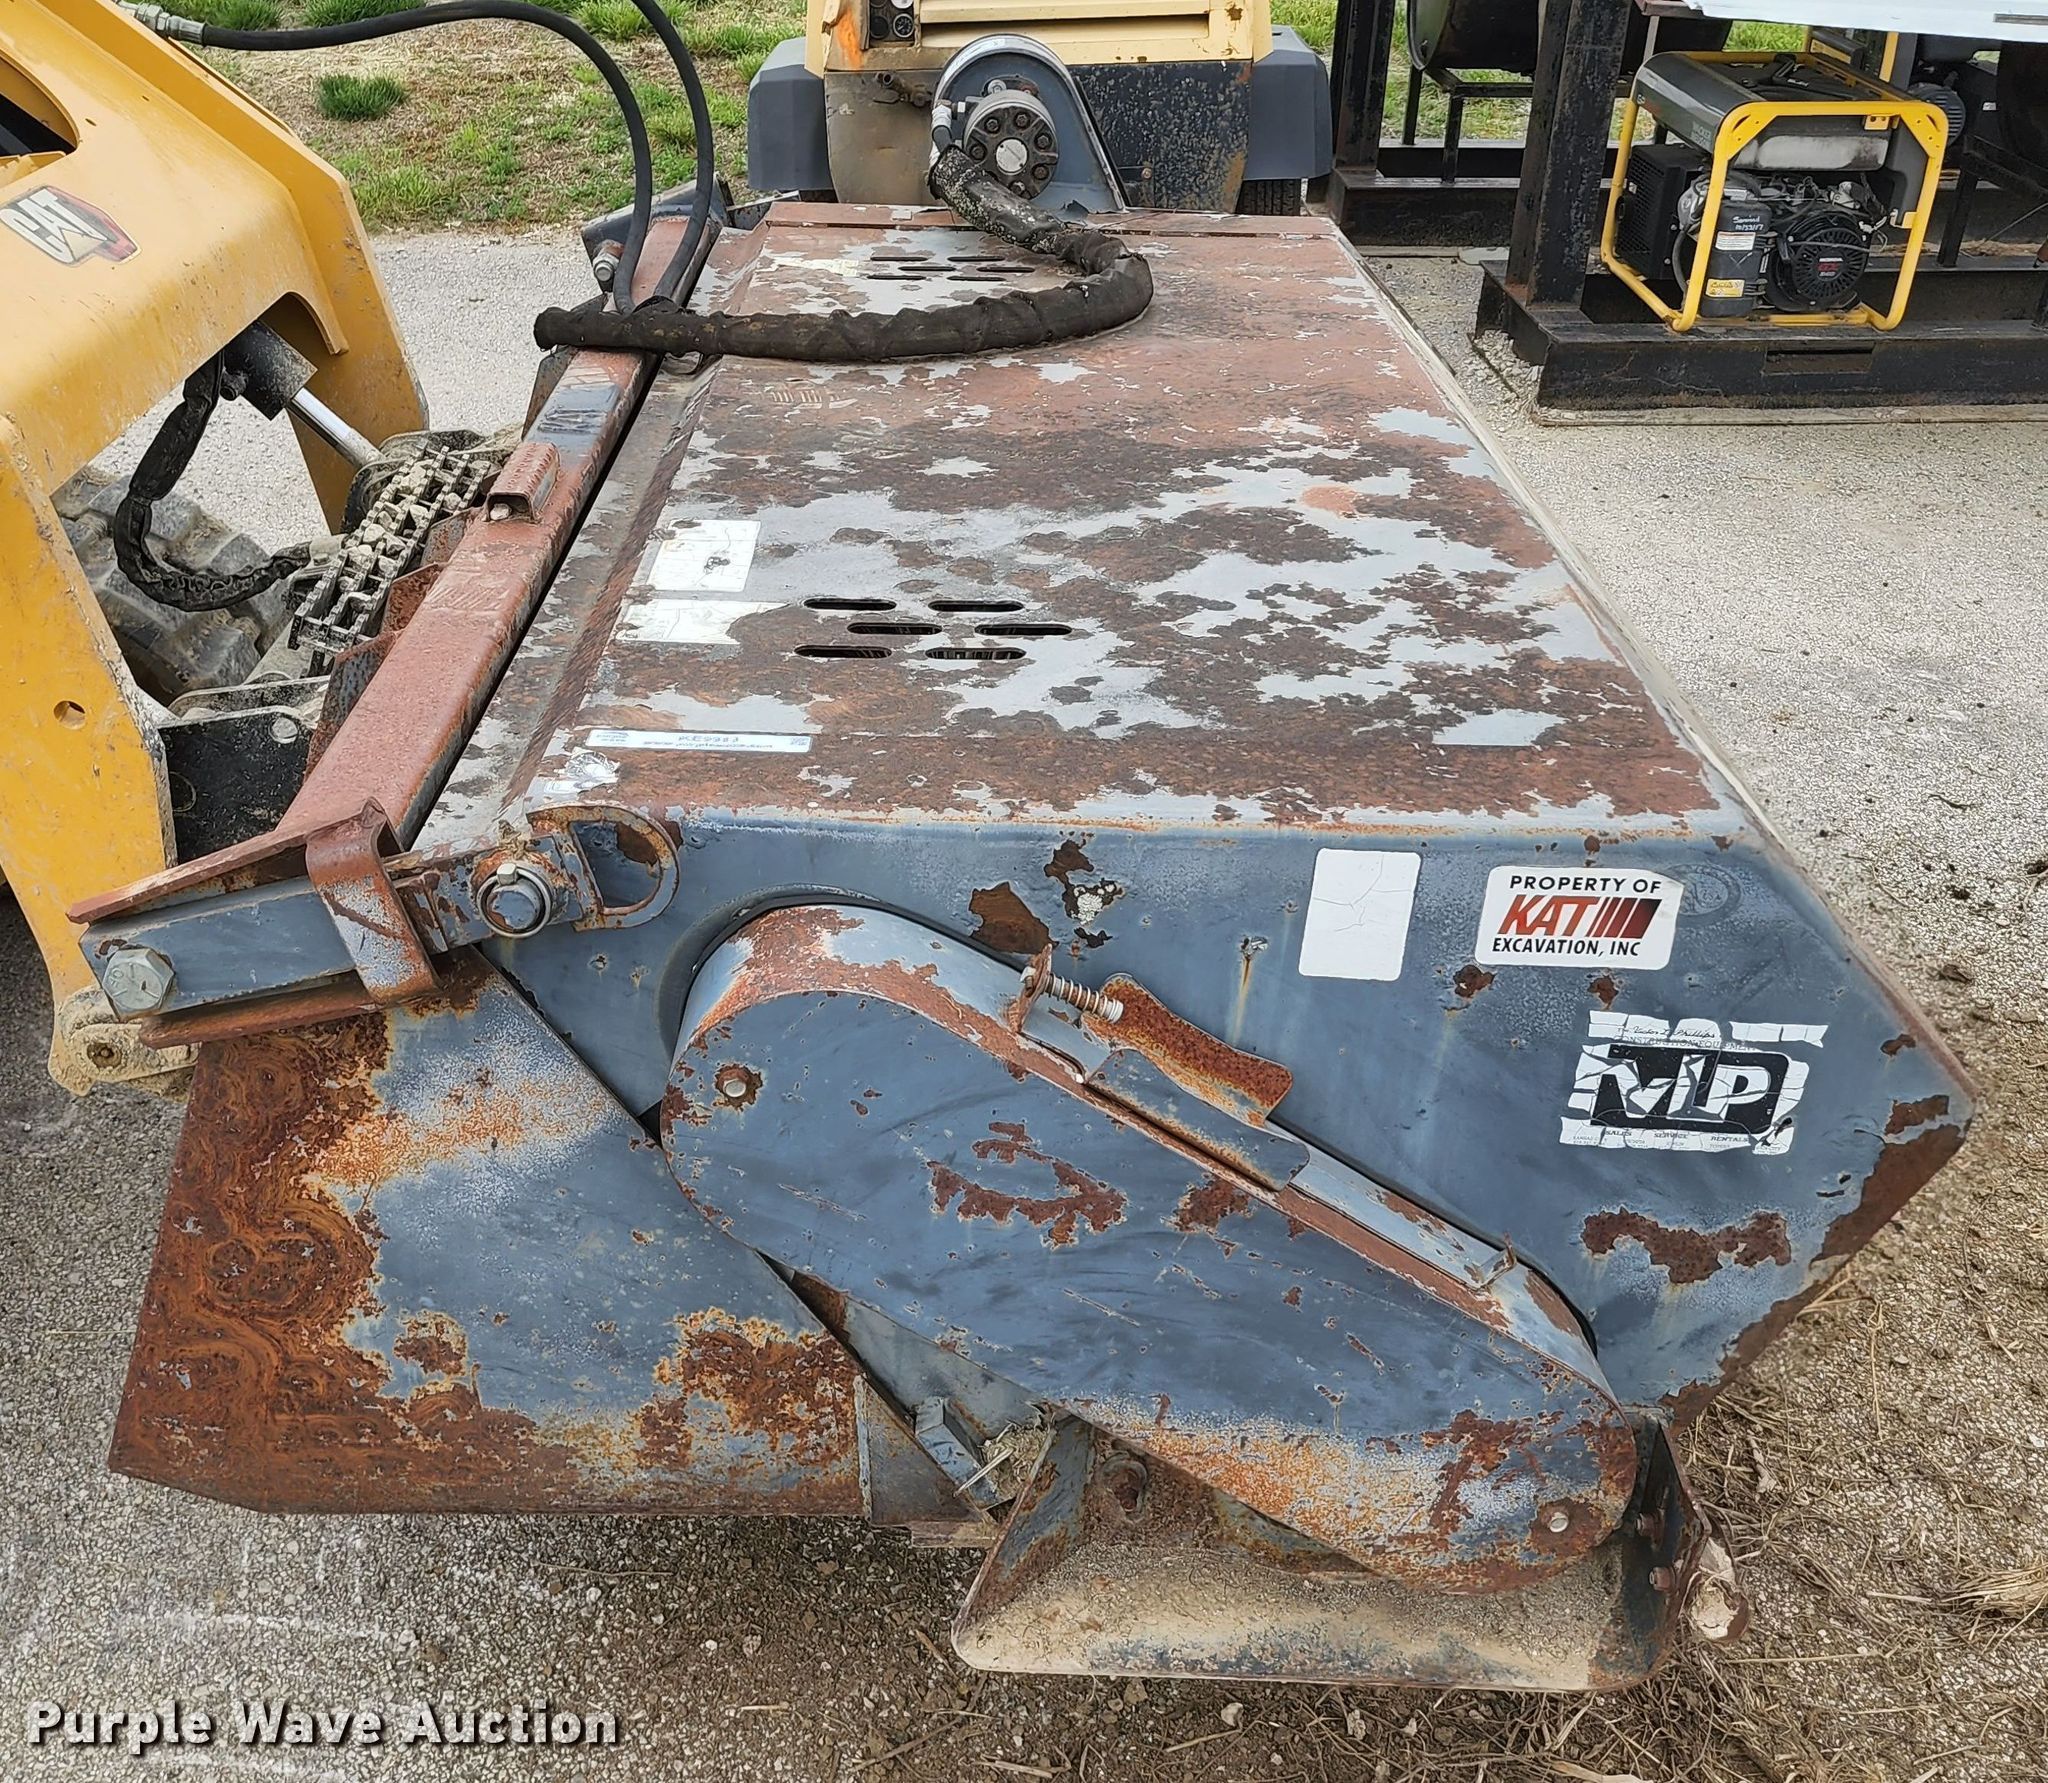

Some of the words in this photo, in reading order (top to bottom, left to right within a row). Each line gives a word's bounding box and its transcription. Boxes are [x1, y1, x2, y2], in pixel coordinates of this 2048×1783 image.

[0, 188, 108, 263] CAT
[1509, 875, 1626, 892] PROPERTY
[1632, 878, 1662, 894] OF
[1497, 894, 1601, 937] KAT
[1492, 937, 1604, 957] EXCAVATION,
[1609, 941, 1641, 957] INC
[1672, 1029, 1716, 1040] Phillips
